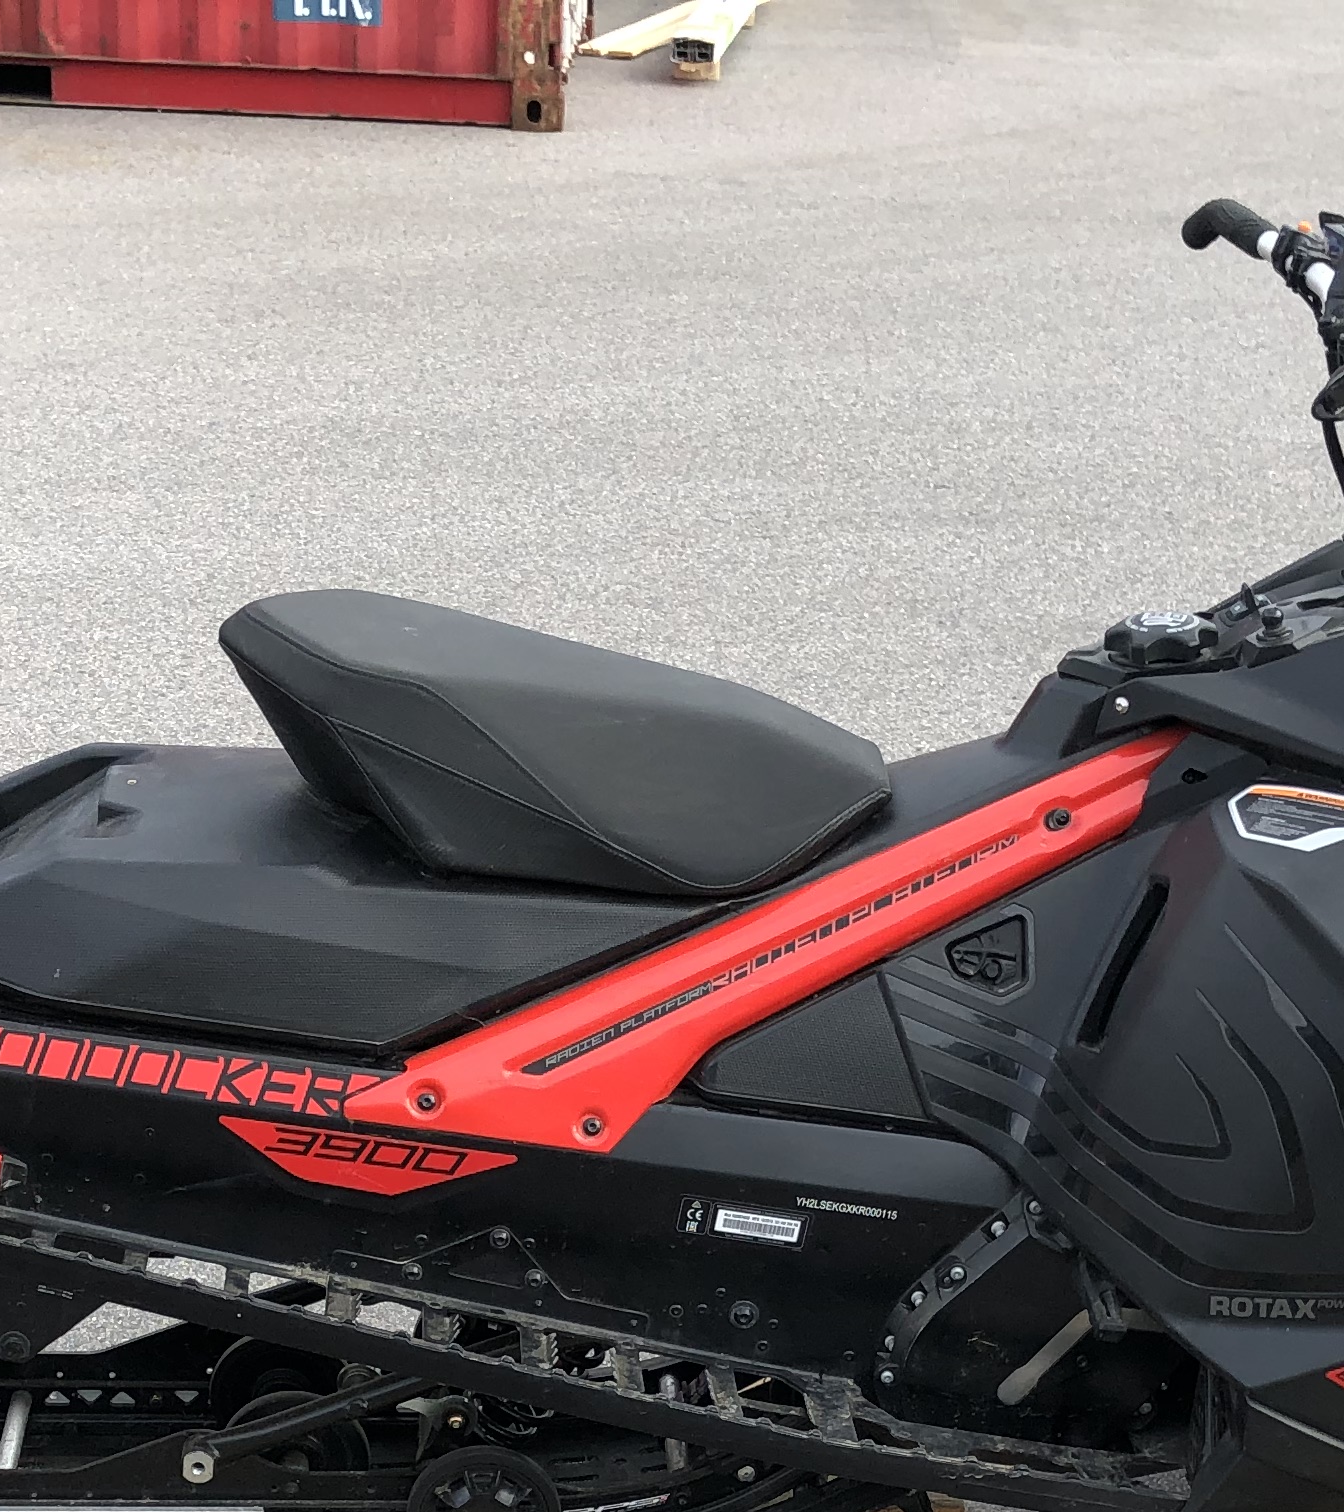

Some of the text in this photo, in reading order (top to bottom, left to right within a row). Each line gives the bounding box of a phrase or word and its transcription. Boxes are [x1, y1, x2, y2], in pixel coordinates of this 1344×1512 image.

[545, 981, 713, 1068] RADIEN PLATFORM
[264, 1126, 469, 1176] 3900
[1209, 1295, 1316, 1319] ROTAX
